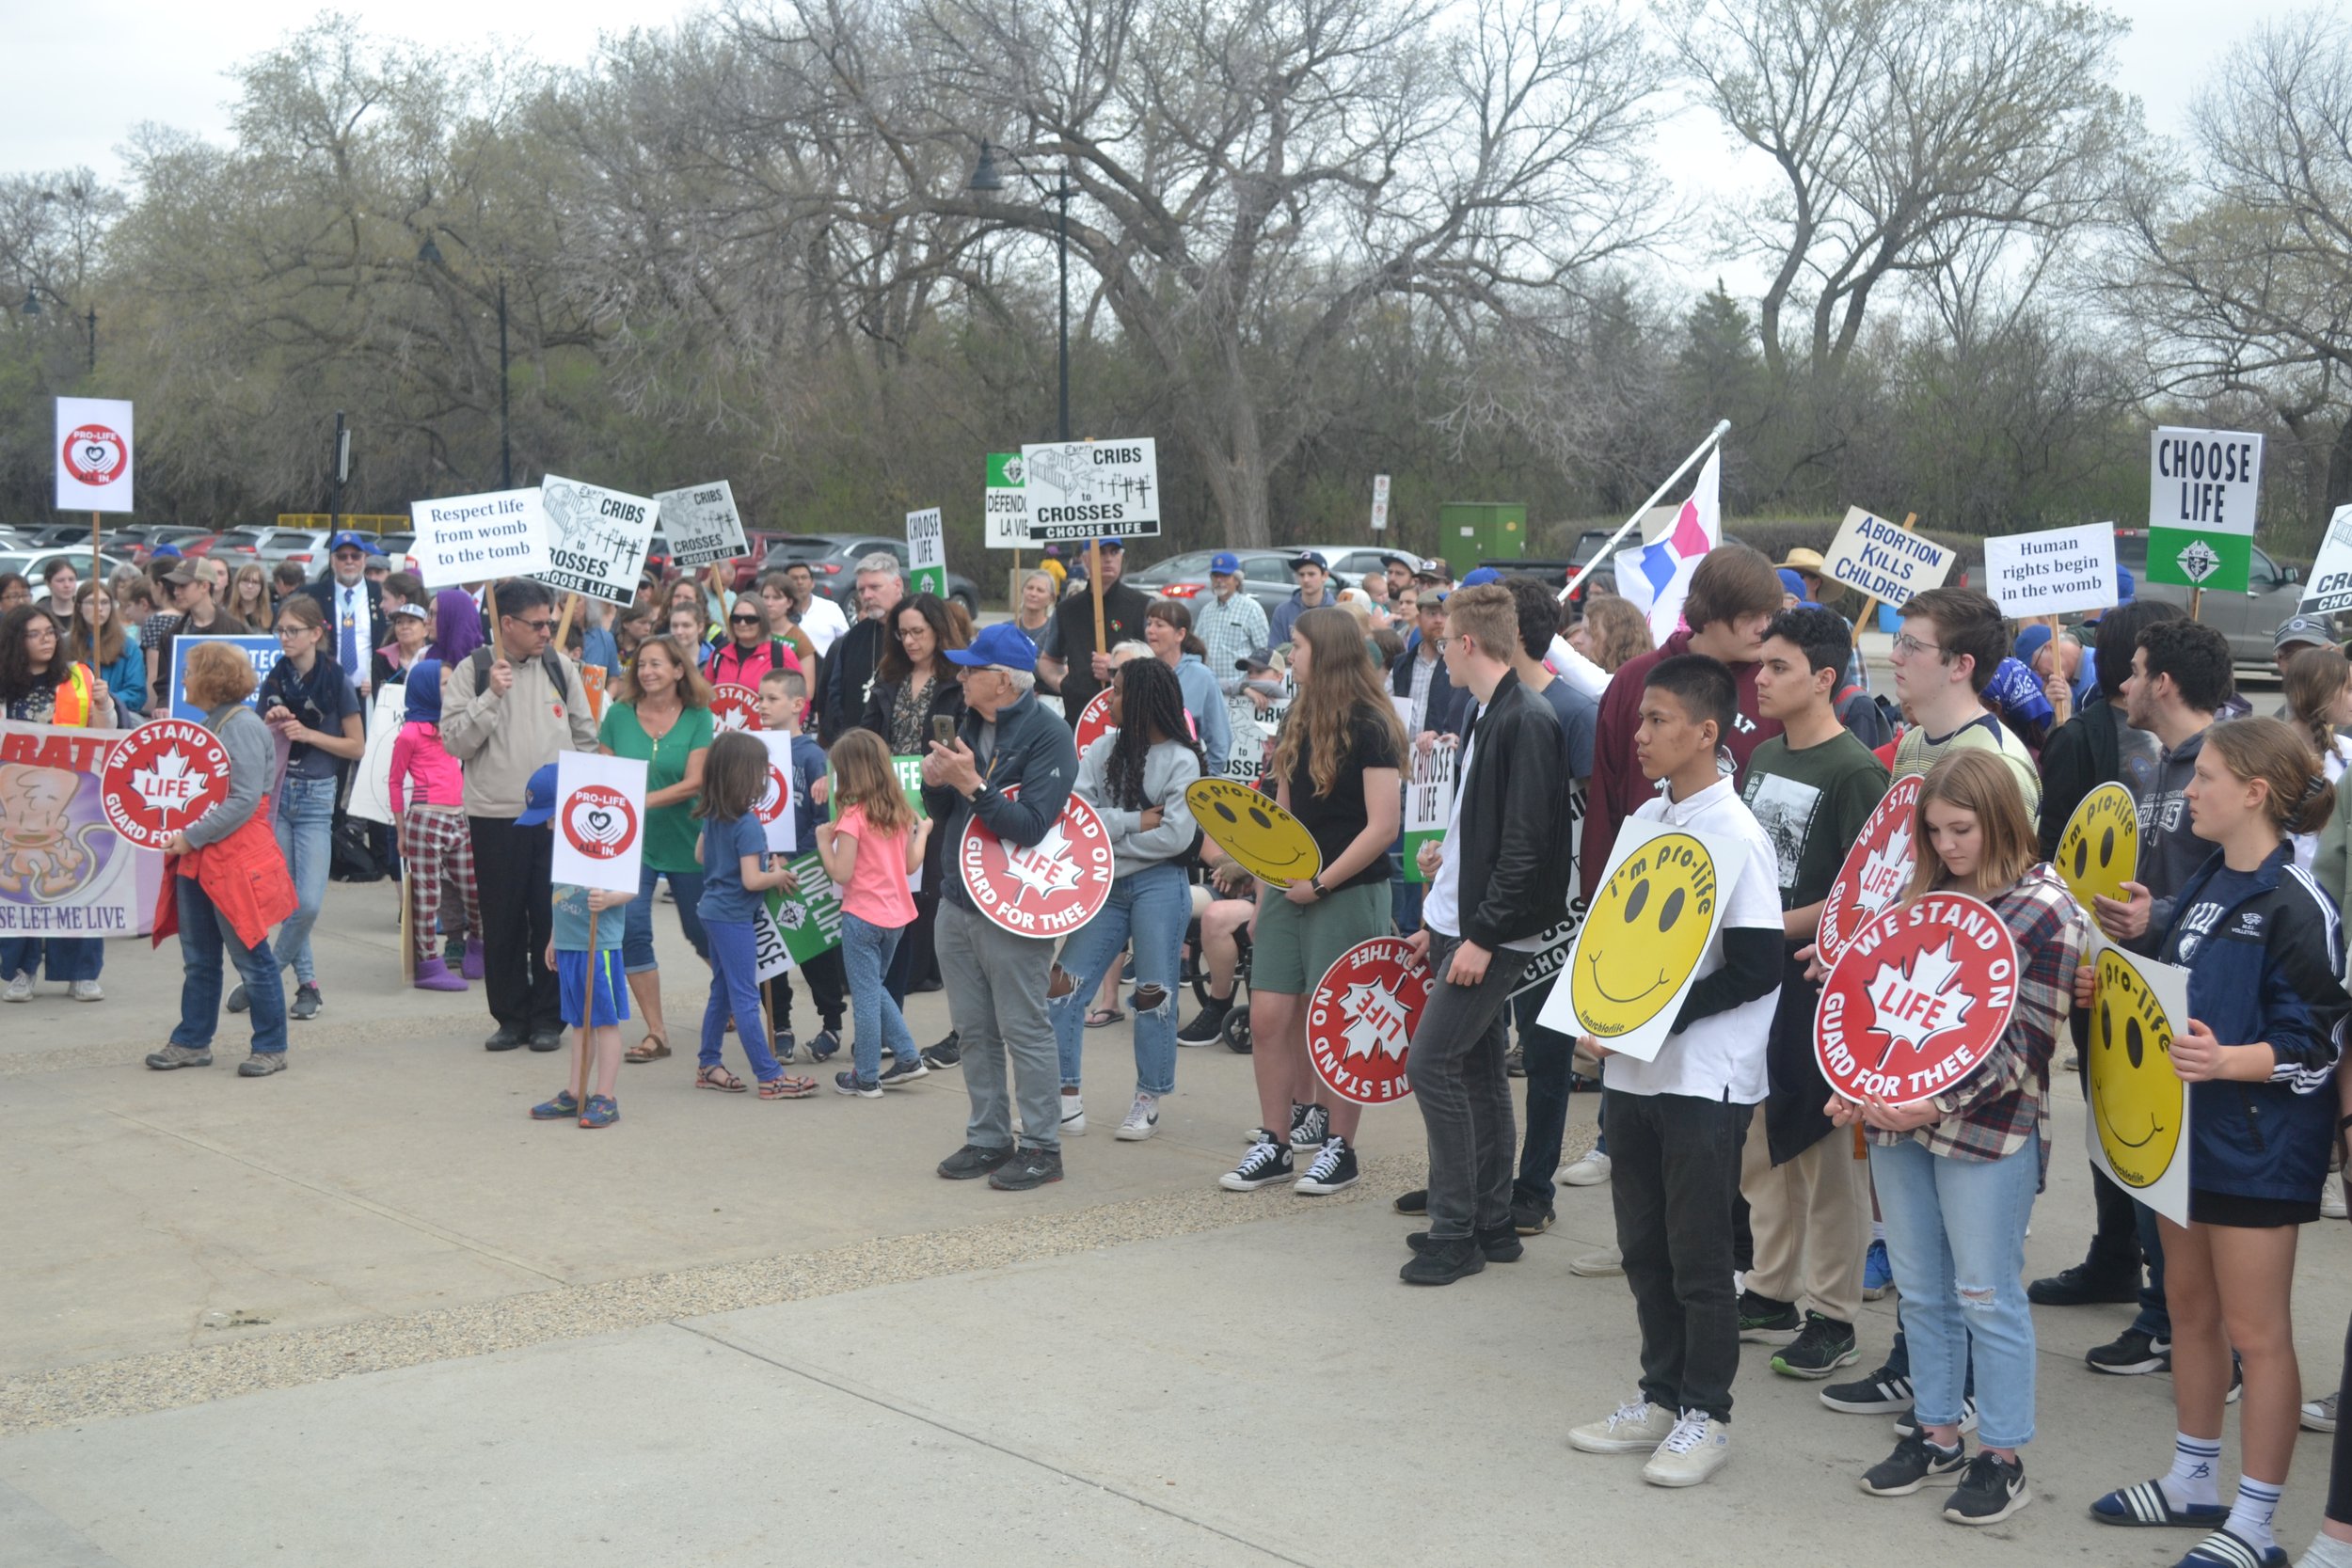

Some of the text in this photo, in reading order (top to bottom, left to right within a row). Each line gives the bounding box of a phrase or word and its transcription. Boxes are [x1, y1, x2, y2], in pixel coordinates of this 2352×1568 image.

[73, 430, 117, 441] PRO-LIFE
[1093, 447, 1142, 466] CRIBS
[2159, 439, 2250, 483] CHOOSE
[431, 498, 525, 523] Respect life
[600, 498, 646, 524] CRIBS
[693, 488, 723, 506] CRIBS
[1081, 492, 1092, 502] to
[2180, 482, 2226, 524] LIFE
[909, 513, 939, 541] CHOOSE
[1000, 518, 1013, 537] LA
[1038, 503, 1124, 524] CROSSES
[435, 518, 528, 545] from womb
[576, 539, 586, 551] to
[674, 533, 723, 554] CROSSES
[1046, 522, 1142, 538] CHOOSE LIFE
[1855, 515, 1943, 568] ABORTION
[438, 541, 531, 565] to the tomb
[548, 546, 610, 578] ROSSES
[681, 546, 738, 565] CHOOSE LIFE
[916, 539, 933, 564] LIFE
[1859, 542, 1915, 580] KILLS
[2020, 538, 2079, 557] Human
[2002, 556, 2099, 581] rights begin
[533, 571, 620, 599] CHOOSE LIFE
[2002, 576, 2102, 600] in the womb
[1083, 698, 1108, 723] WE
[110, 723, 230, 779] WE STAND ON
[1238, 747, 1248, 757] to
[1411, 747, 1451, 786] CHOOSE
[144, 778, 190, 799] LIFE
[576, 791, 628, 808] PRO-LIFE
[1209, 784, 1291, 822] pro-life
[105, 792, 148, 840] GUARD
[1418, 786, 1438, 823] LIFE
[2087, 795, 2134, 837] pro-life
[1859, 806, 1885, 847] WE
[1010, 844, 1063, 886] LIFE
[1091, 847, 1109, 882] ON
[788, 855, 834, 908] LOVE
[966, 836, 1088, 930] GUARD FOR THEE
[1610, 845, 1714, 916] i'm pro-life
[1862, 863, 1900, 898] LIFE
[21, 905, 52, 929] LET
[56, 906, 83, 929] ME
[87, 907, 126, 929] LIVE
[1822, 880, 1847, 951] GUARD
[1350, 943, 1391, 970] THEE
[1853, 901, 2011, 1008] WE STAND ON
[1312, 987, 1334, 1027] ON
[1356, 990, 1403, 1042] LIFE
[1879, 982, 1947, 1031] LIFE
[2106, 962, 2170, 1053] pro-life
[1822, 992, 1976, 1097] GUARD FOR THEE
[1314, 1036, 1373, 1098] STAND
